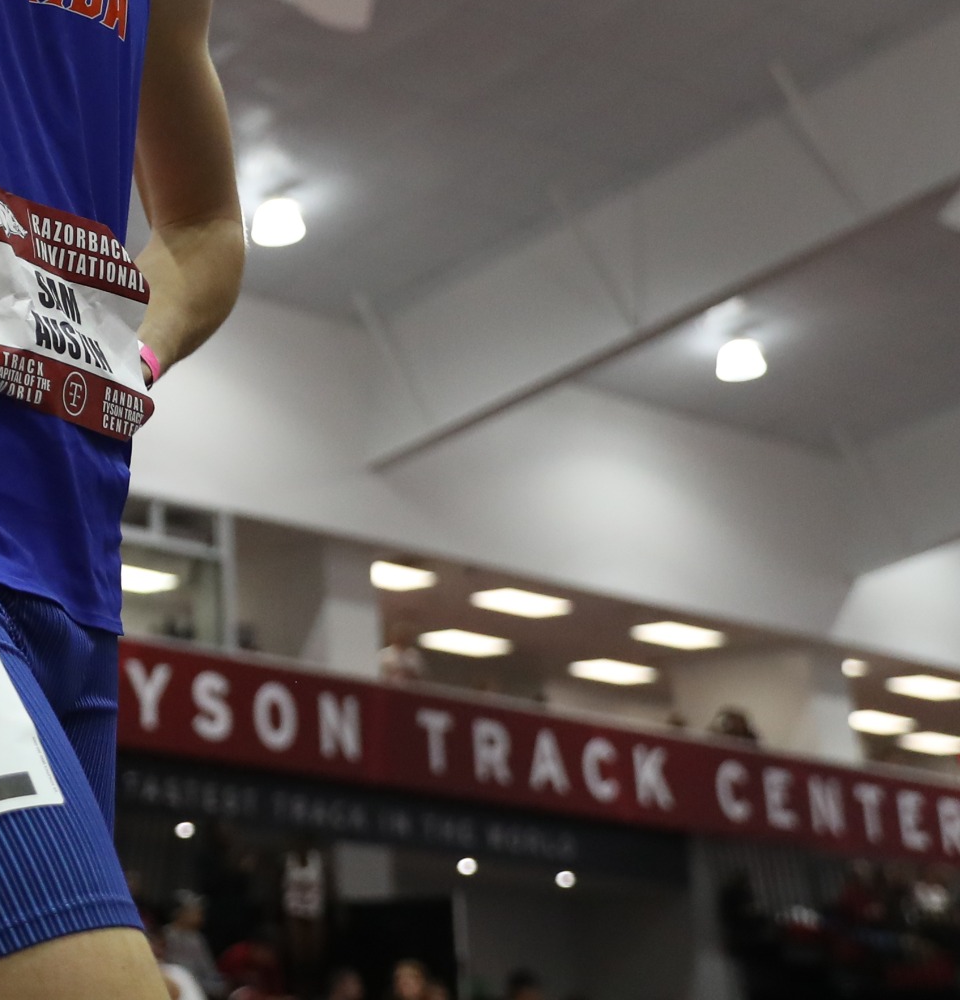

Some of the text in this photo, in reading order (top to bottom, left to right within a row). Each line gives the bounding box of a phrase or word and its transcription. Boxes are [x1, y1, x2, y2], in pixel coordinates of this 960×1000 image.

[35, 238, 145, 293] INVITATIONAL
[34, 270, 82, 325] SAM
[31, 309, 113, 375] AUSTIN
[3, 351, 44, 377] TRACK
[24, 373, 36, 387] OF
[36, 377, 51, 392] THE
[102, 401, 124, 418] TYSON
[104, 386, 144, 413] RANDAL
[123, 657, 363, 764] YSON
[415, 707, 676, 812] TRACK
[714, 758, 960, 858] CENTER
